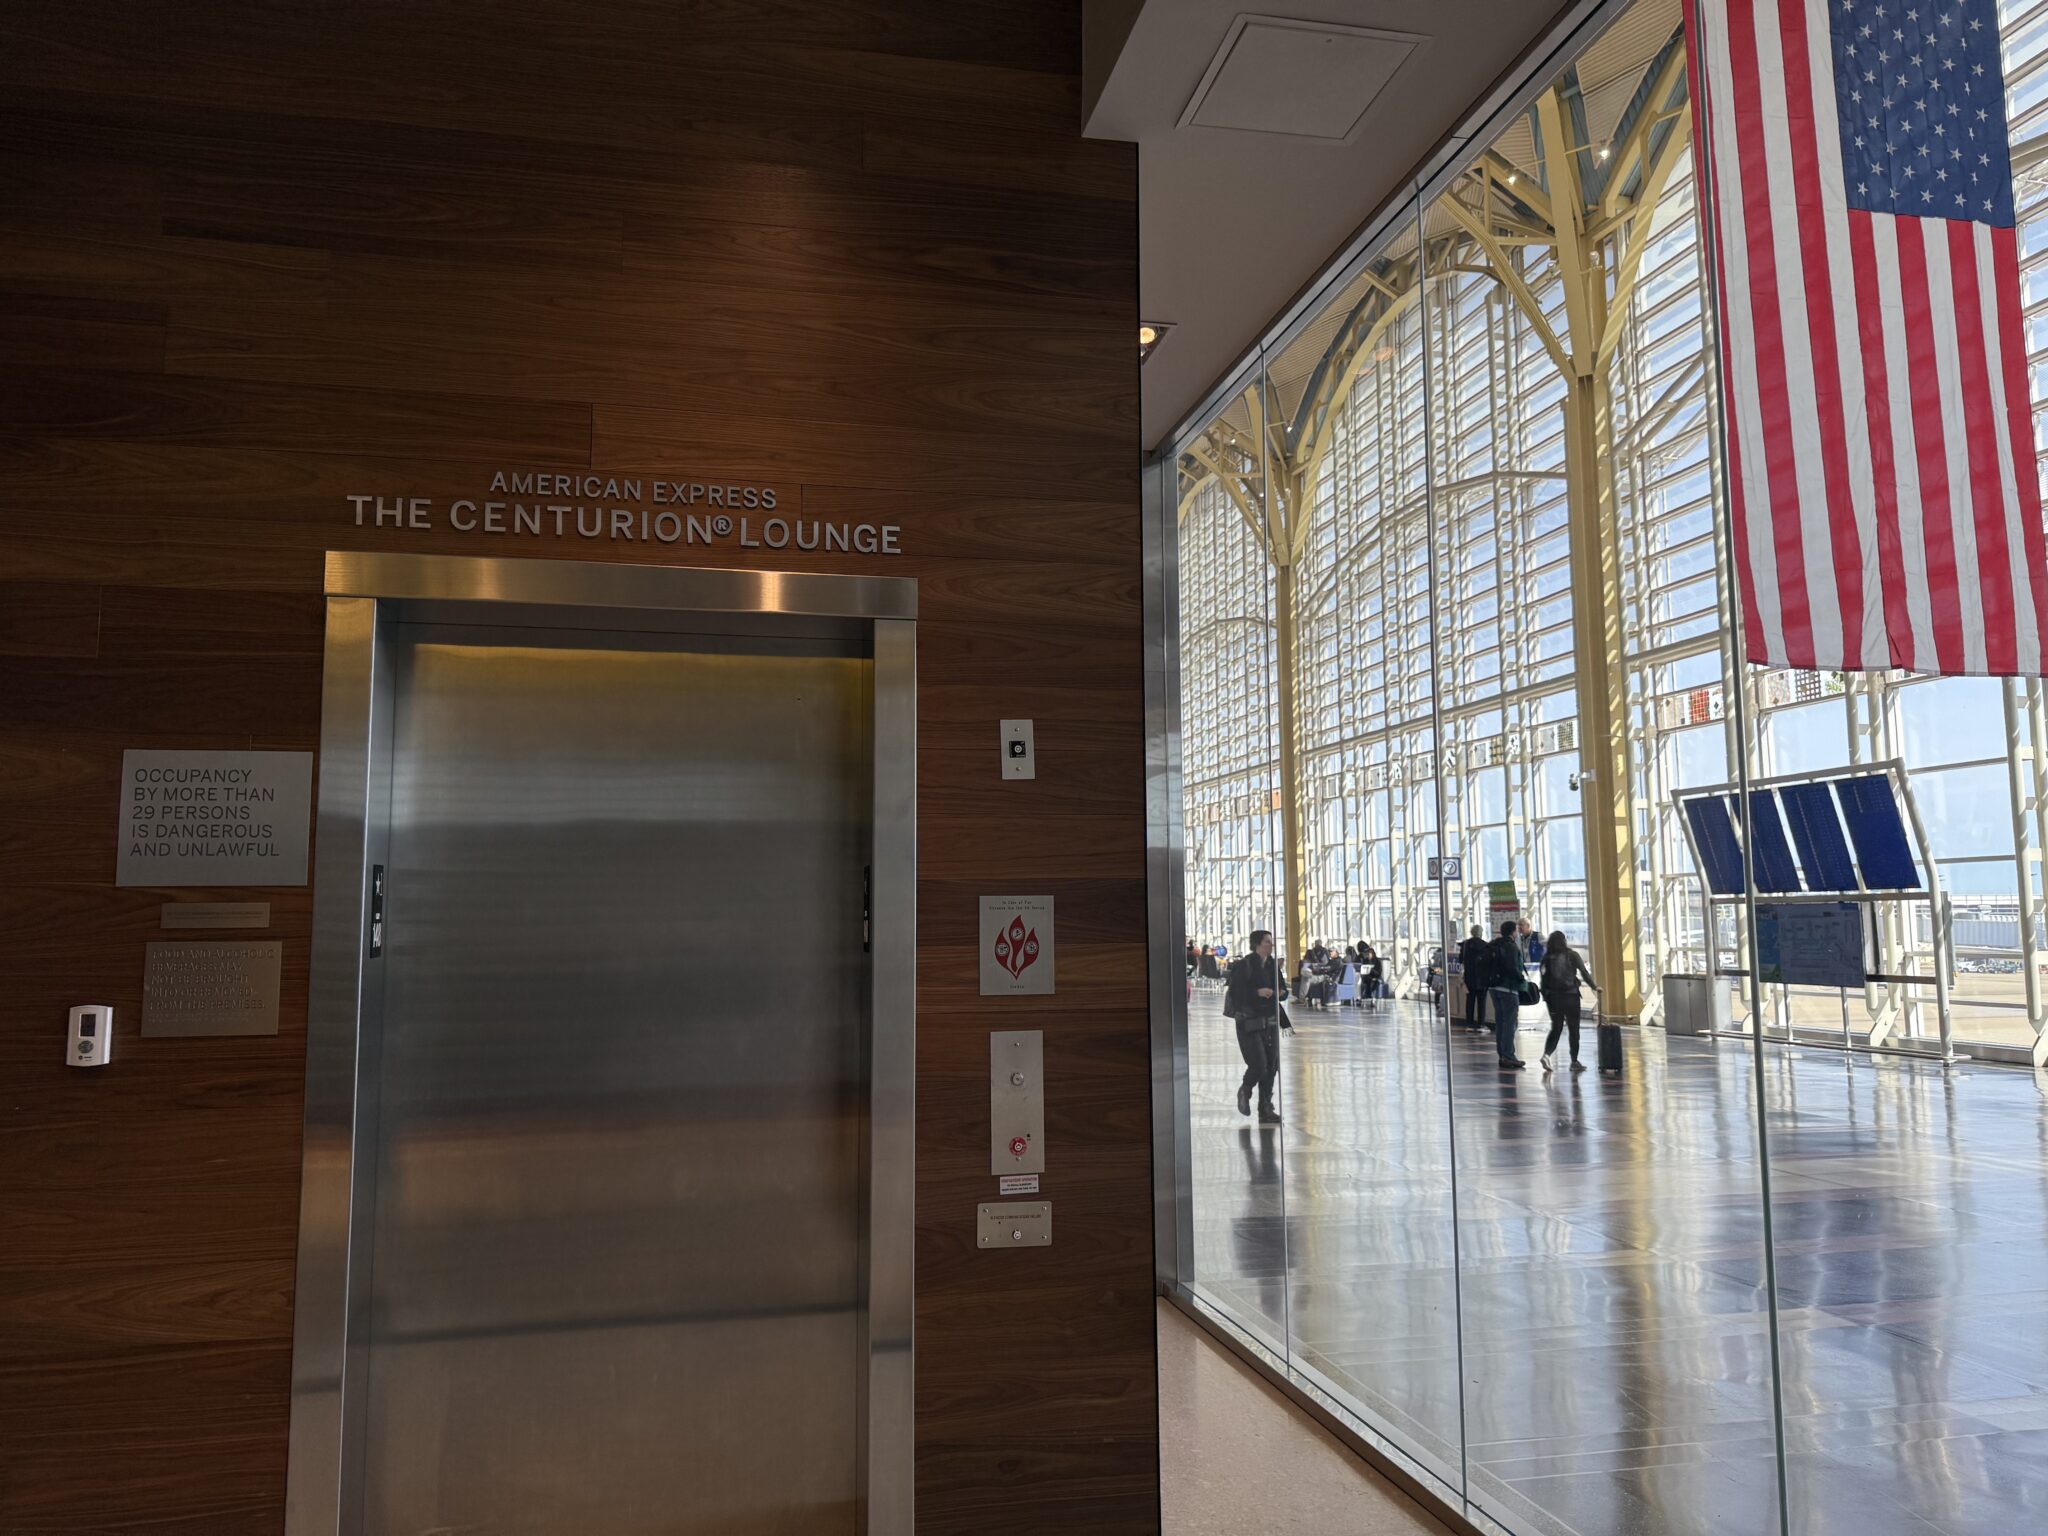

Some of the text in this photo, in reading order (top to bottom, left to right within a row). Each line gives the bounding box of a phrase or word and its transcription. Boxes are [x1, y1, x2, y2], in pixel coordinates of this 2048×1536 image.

[490, 471, 777, 510] AMERICAN EXPRESS
[347, 495, 432, 529] THE
[739, 518, 902, 554] LOUNGE
[134, 768, 252, 783] OCCUPANCY
[134, 787, 275, 802] BY MORE THAN
[132, 806, 250, 820] 29 PERSONS
[132, 824, 273, 838] IS DANGEROUS
[130, 842, 279, 857] AND UNLAWFUL
[153, 948, 274, 959] FOOD AND ALCOHOLIC
[152, 962, 243, 971] BEVERAGES MAY
[152, 975, 174, 984] NOT
[195, 974, 249, 984] BROUGHT
[151, 988, 178, 998] INTO
[150, 1000, 182, 1010] FROM
[187, 1000, 205, 1009] THE
